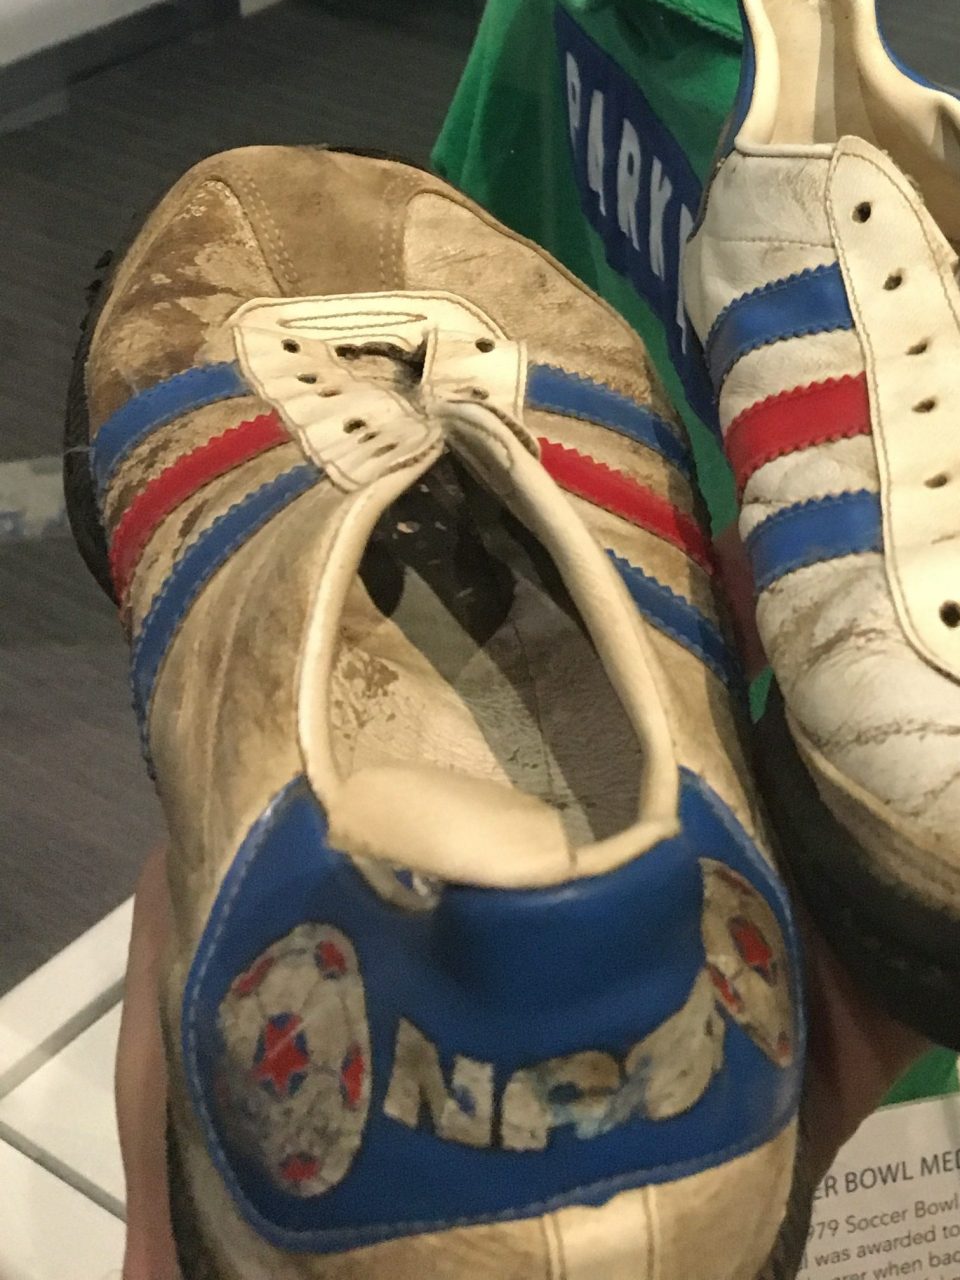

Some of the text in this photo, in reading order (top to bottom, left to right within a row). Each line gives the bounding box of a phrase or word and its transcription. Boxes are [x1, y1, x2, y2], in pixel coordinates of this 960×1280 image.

[844, 1161, 913, 1193] BOWL
[845, 1209, 907, 1233] Soccer
[914, 1193, 958, 1218] Bowl
[815, 1248, 850, 1266] was
[855, 1225, 935, 1258] awarded
[941, 1225, 960, 1239] to
[873, 1259, 922, 1280] when
